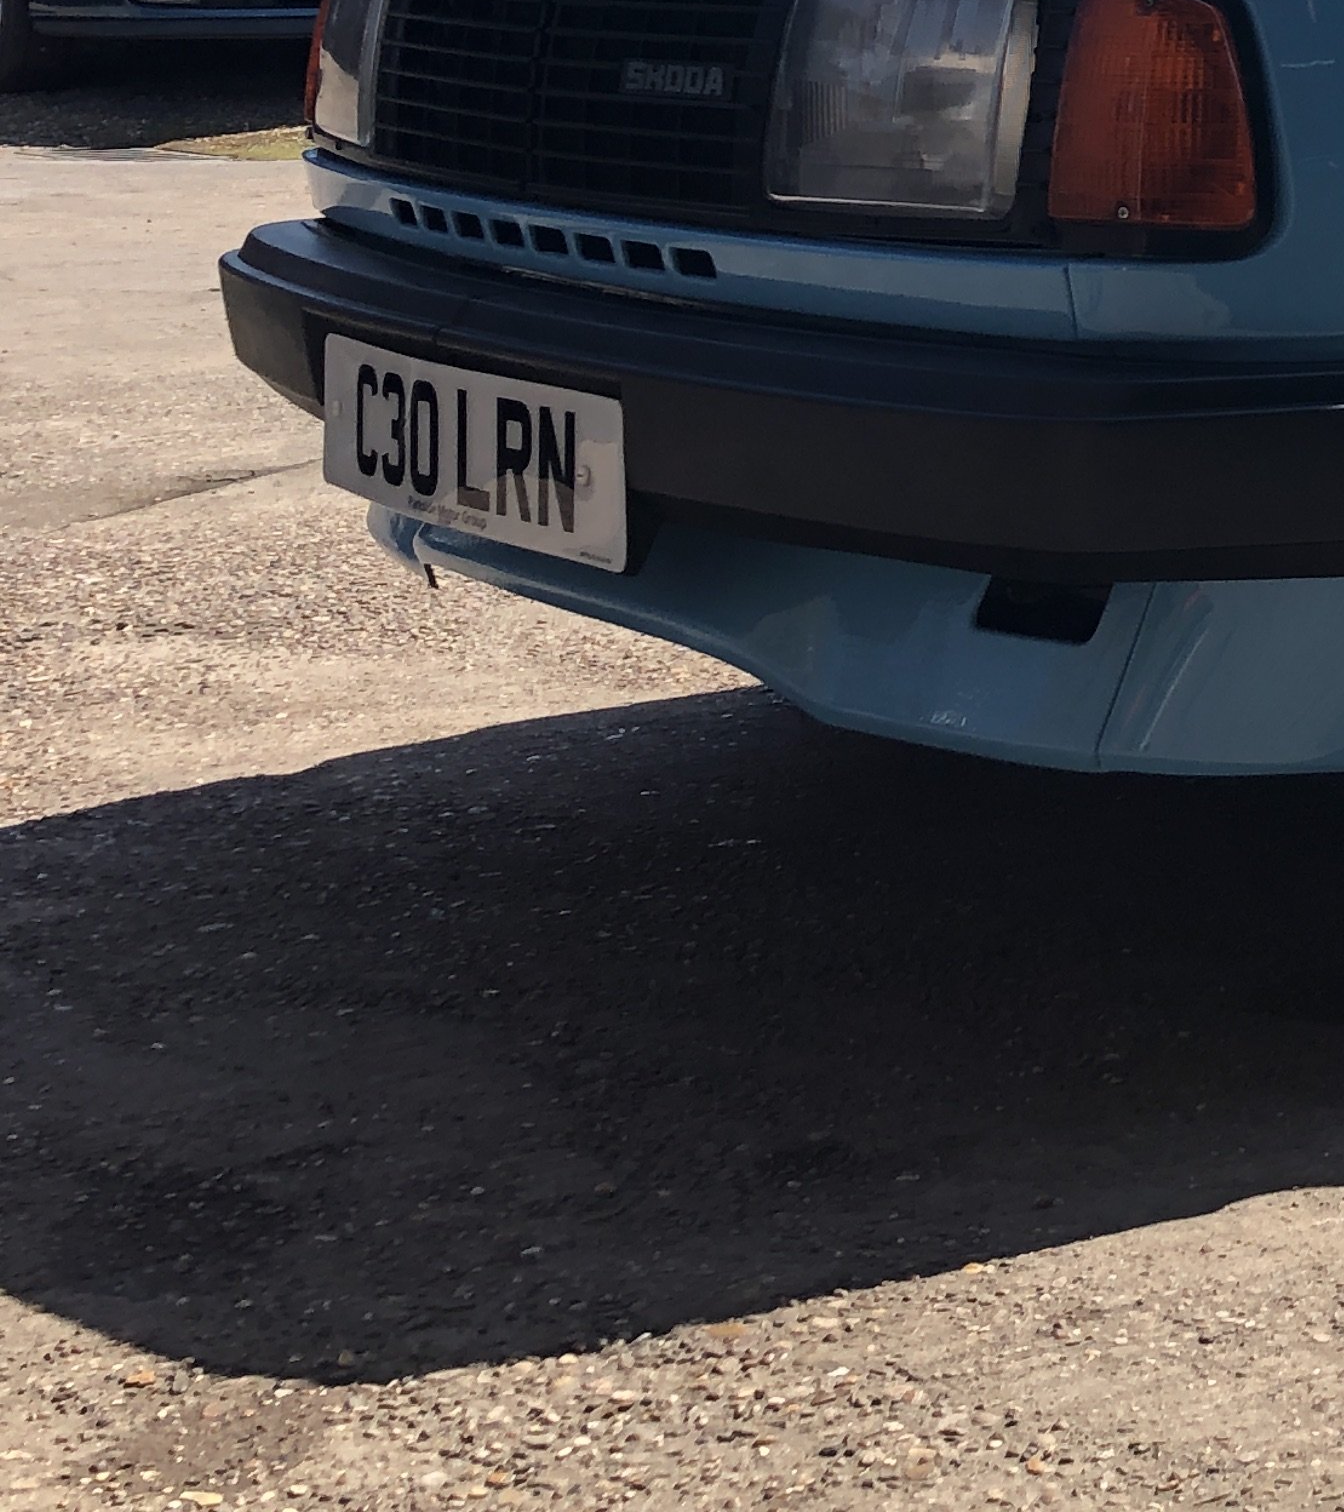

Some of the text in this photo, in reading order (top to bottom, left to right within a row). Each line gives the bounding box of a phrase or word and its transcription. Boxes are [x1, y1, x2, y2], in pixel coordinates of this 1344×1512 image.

[625, 60, 723, 97] SKODA
[357, 364, 576, 533] C30 LRN
